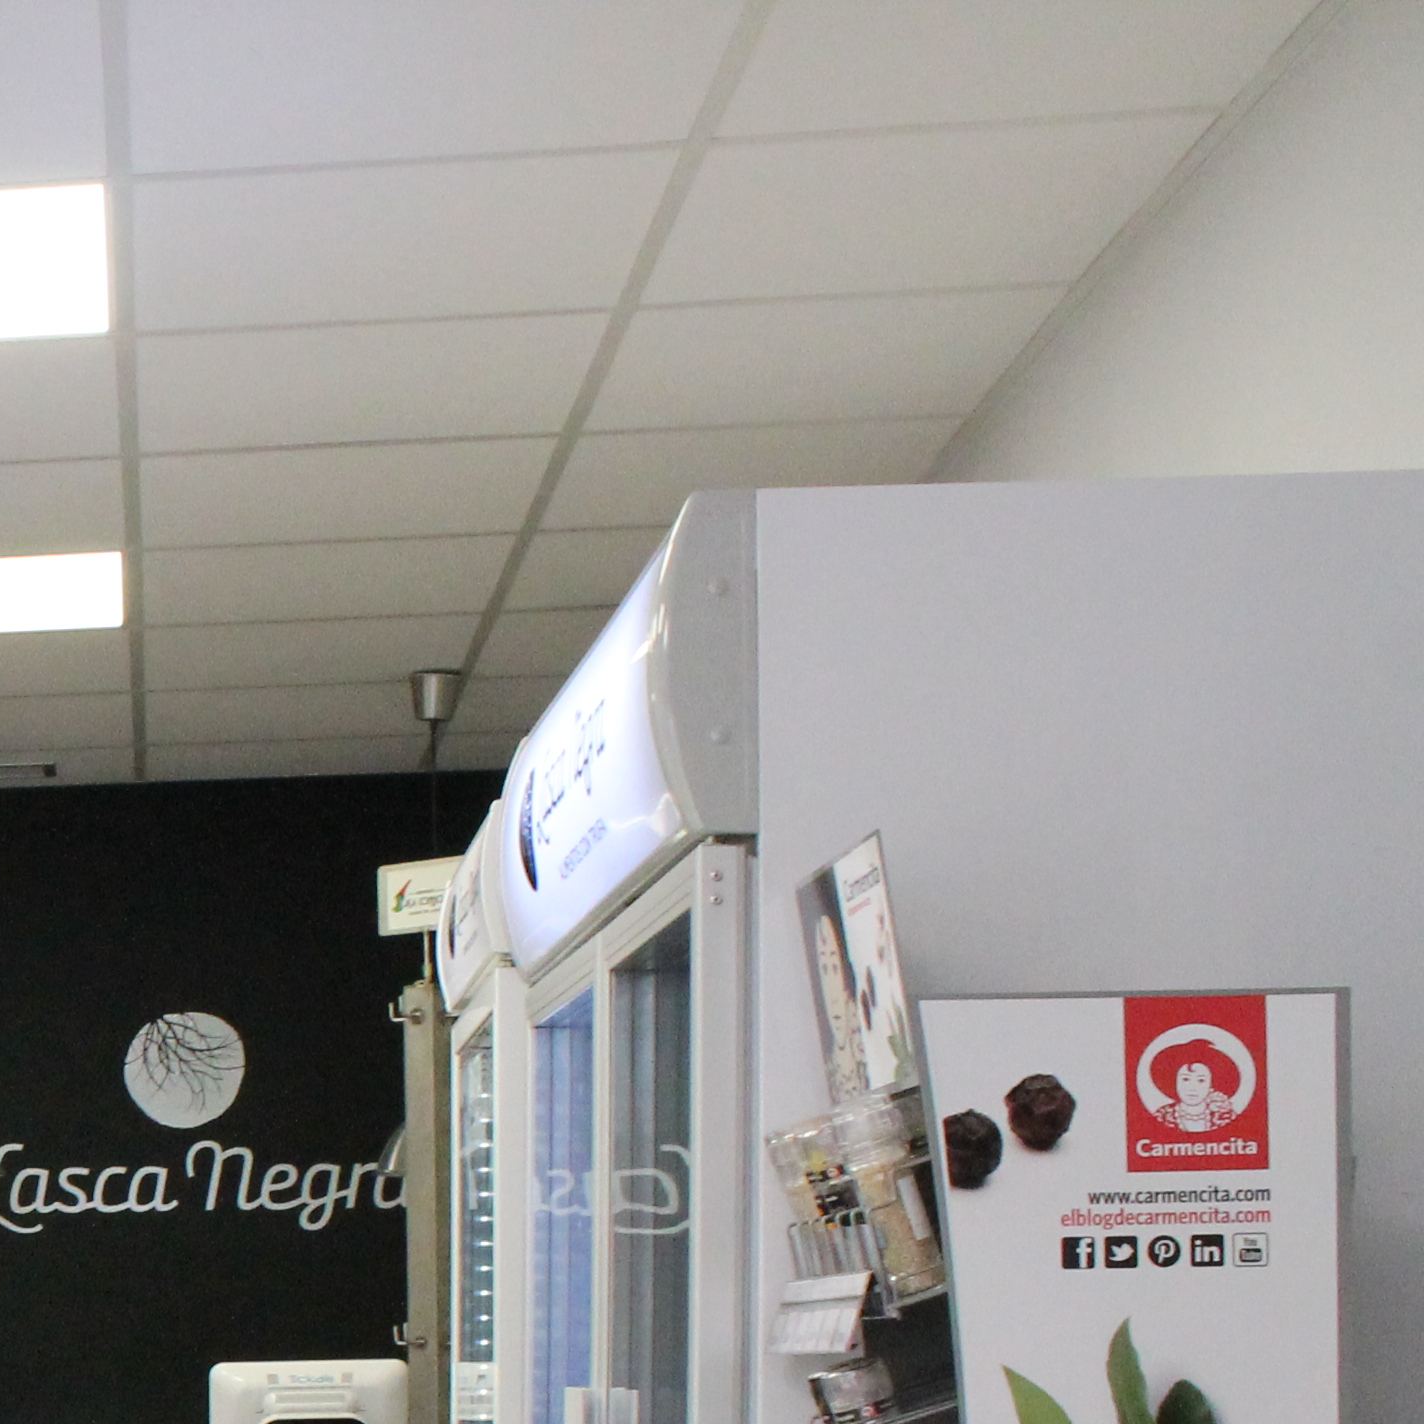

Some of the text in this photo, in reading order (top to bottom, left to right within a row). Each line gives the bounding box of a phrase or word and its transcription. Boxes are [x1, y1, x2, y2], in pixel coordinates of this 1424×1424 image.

[1135, 1138, 1259, 1158] Carmencita
[1087, 1185, 1271, 1205] www.carmencita.com
[1060, 1207, 1271, 1230] elblogdecarmencita.com
